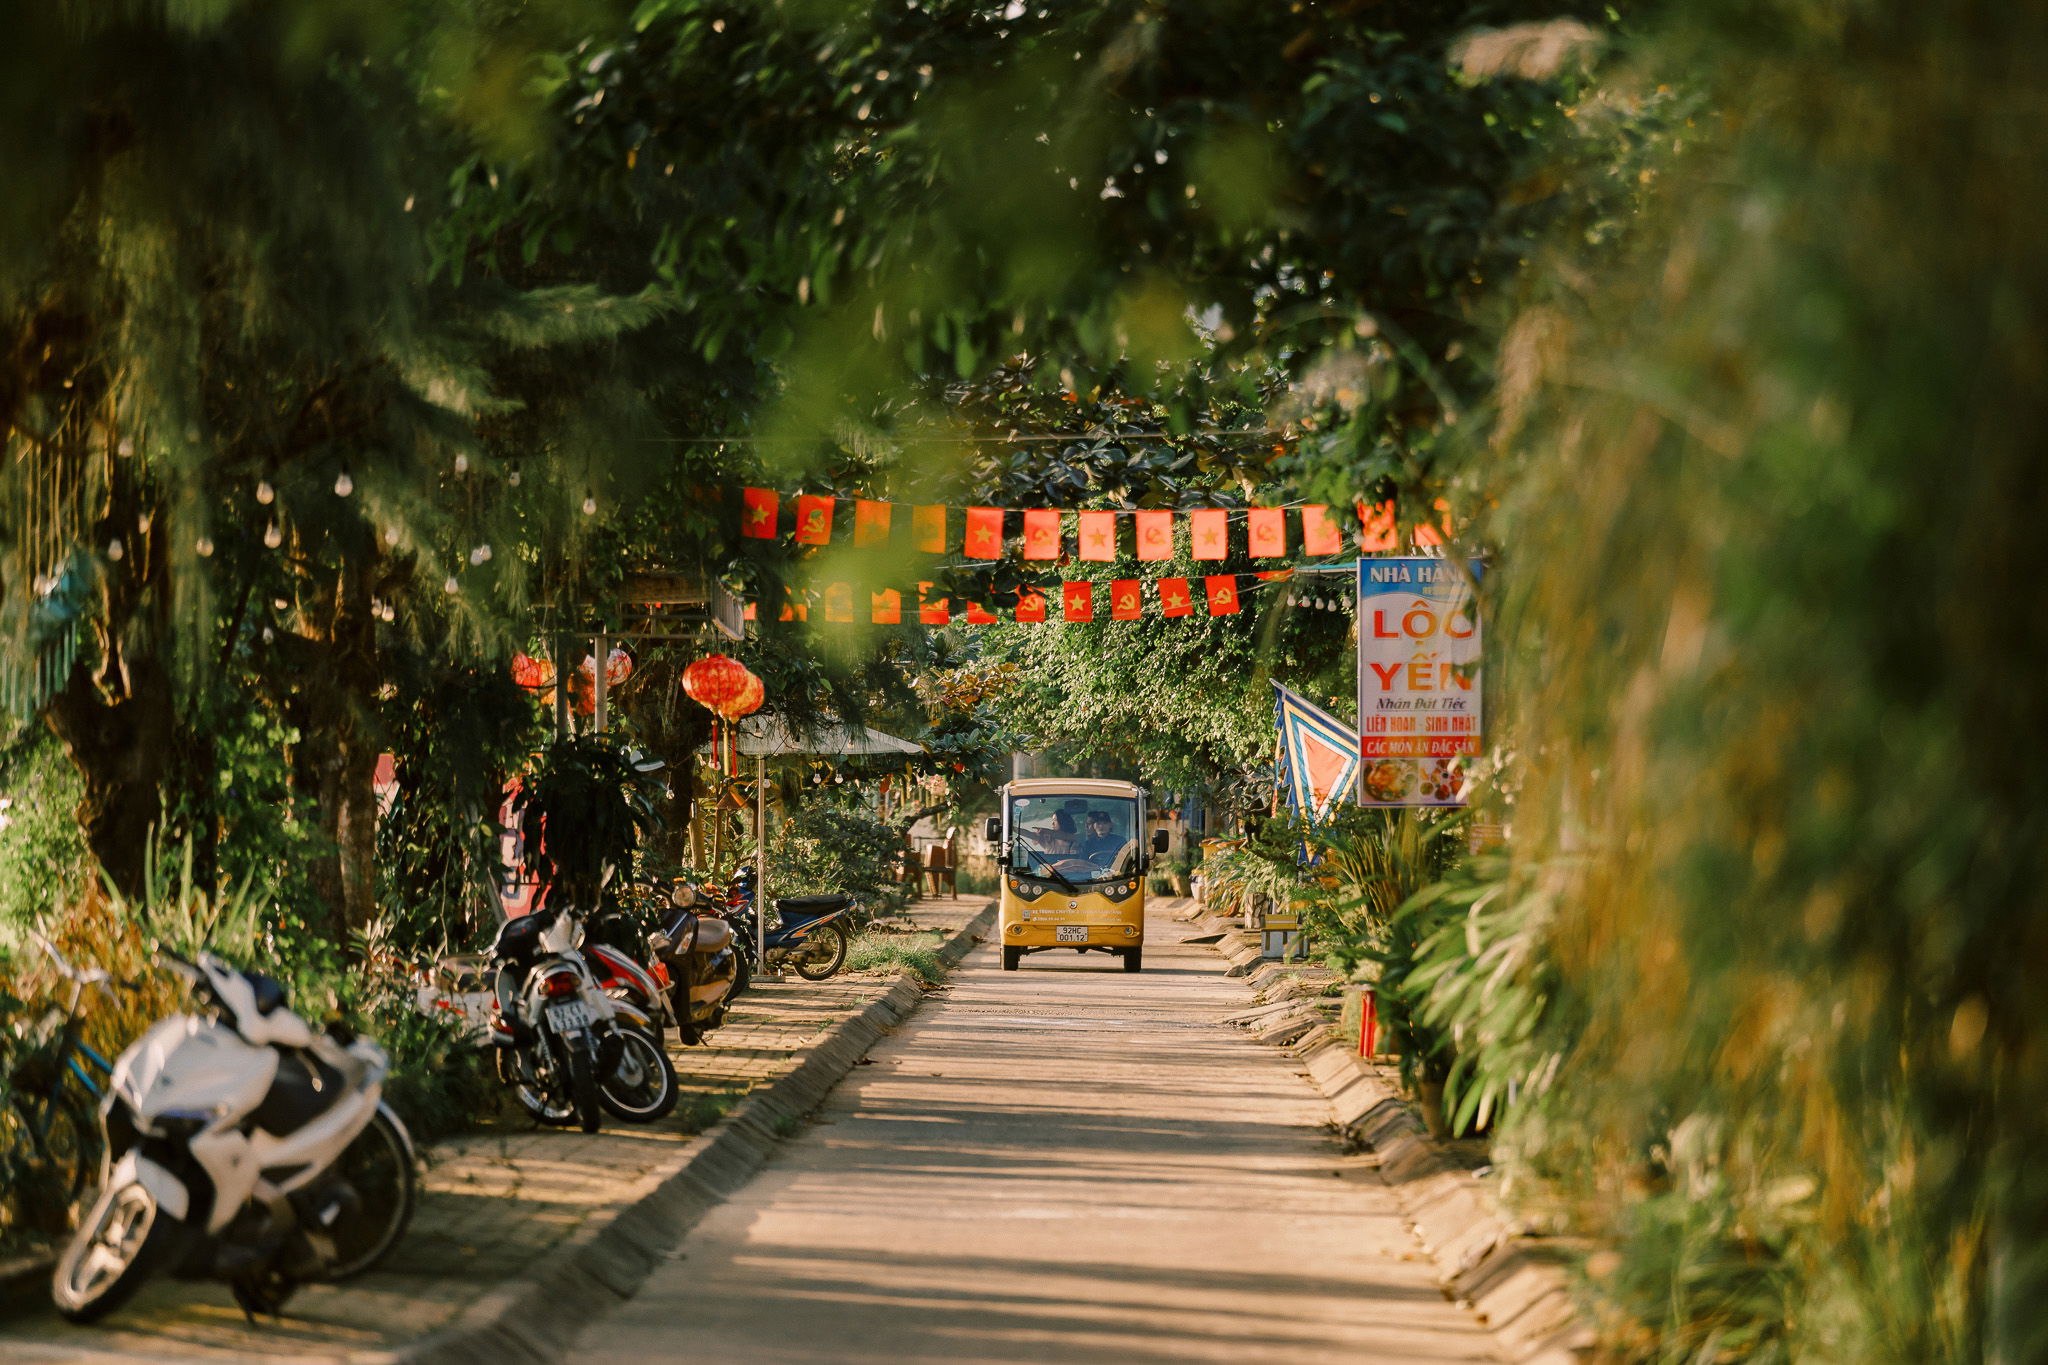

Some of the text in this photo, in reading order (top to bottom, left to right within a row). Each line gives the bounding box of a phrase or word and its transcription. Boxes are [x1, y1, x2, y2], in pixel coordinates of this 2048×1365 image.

[1370, 563, 1411, 583] NHÀ
[1374, 600, 1473, 645] LỘC
[1425, 716, 1448, 732] SINH
[1366, 738, 1386, 754] CÁC
[1062, 927, 1082, 935] 92HC
